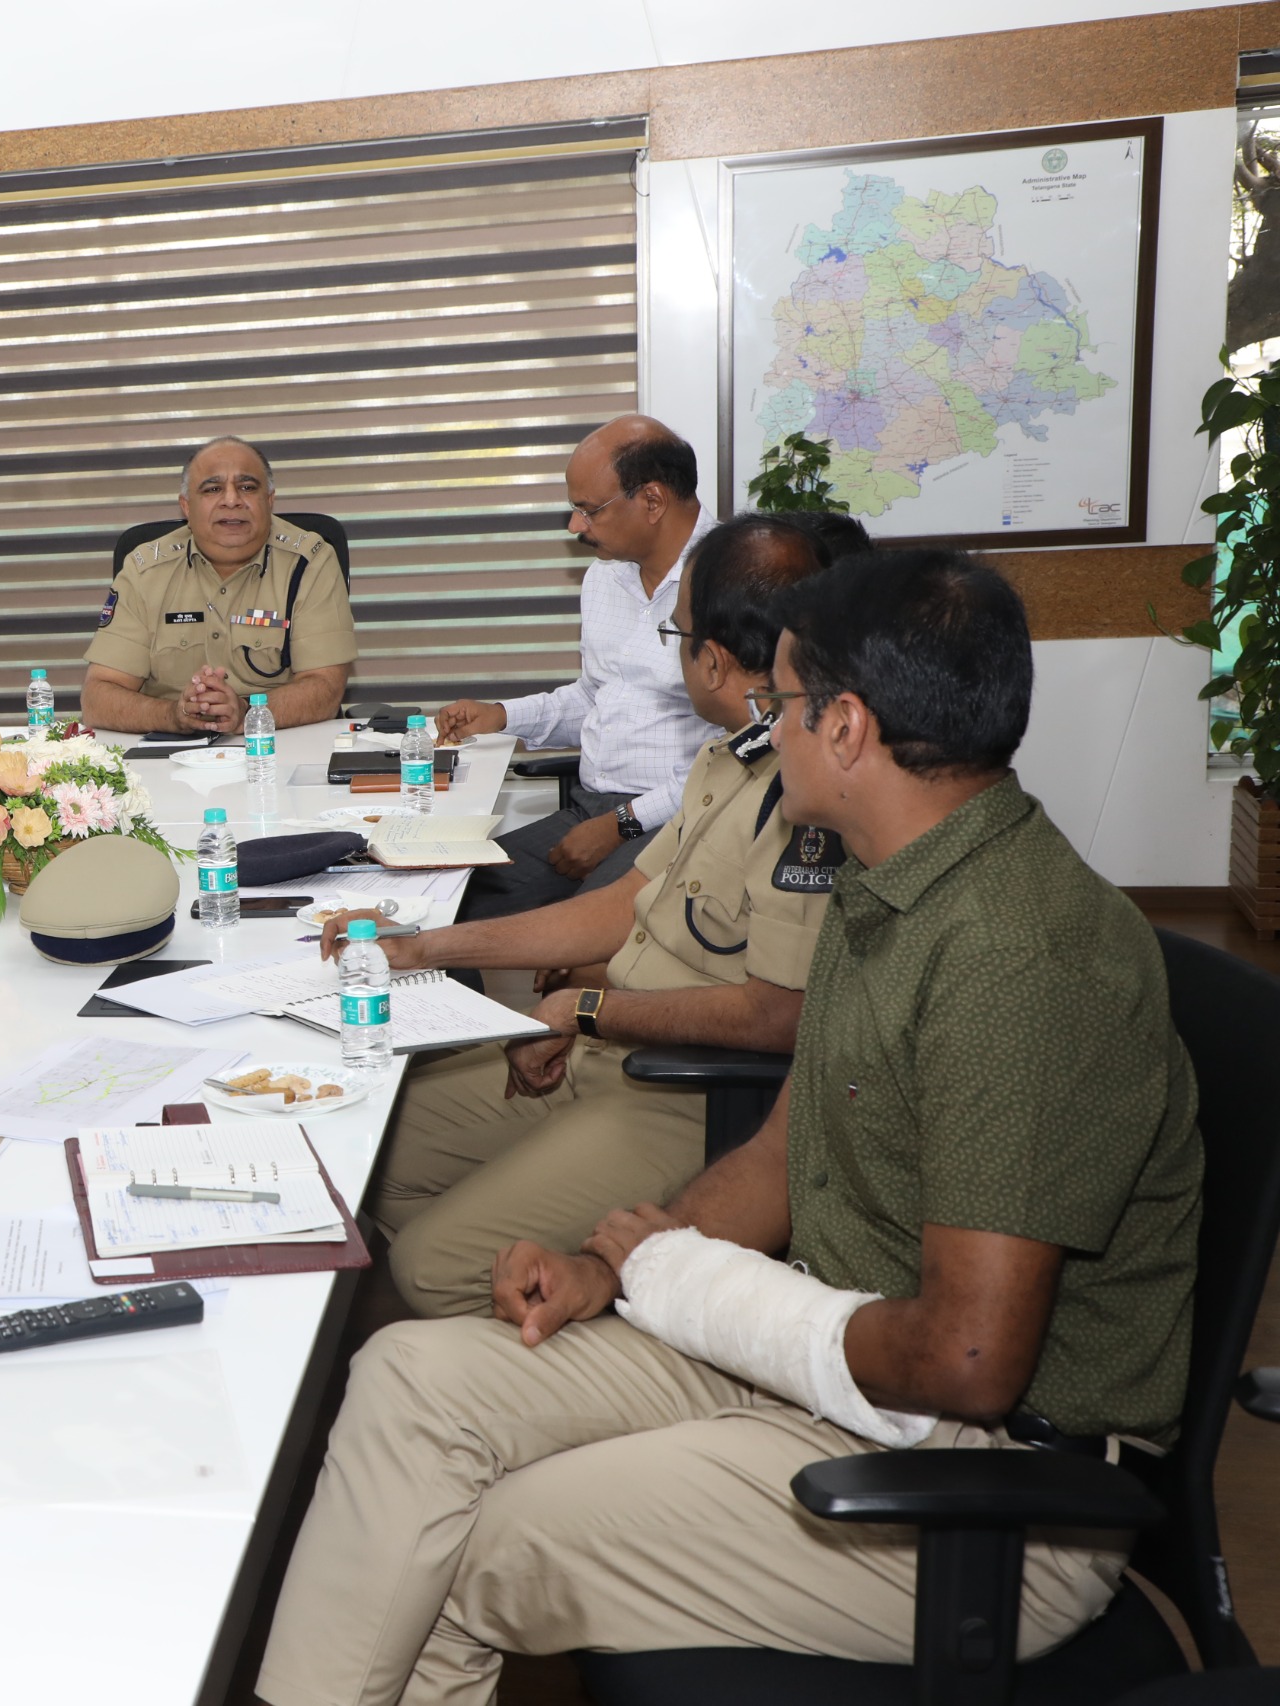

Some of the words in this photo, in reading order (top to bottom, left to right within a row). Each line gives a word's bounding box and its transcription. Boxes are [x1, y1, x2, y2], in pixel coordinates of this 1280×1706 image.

[1022, 174, 1070, 184] Administrative
[1072, 173, 1087, 181] Map
[783, 865, 820, 875] HYDERABAD
